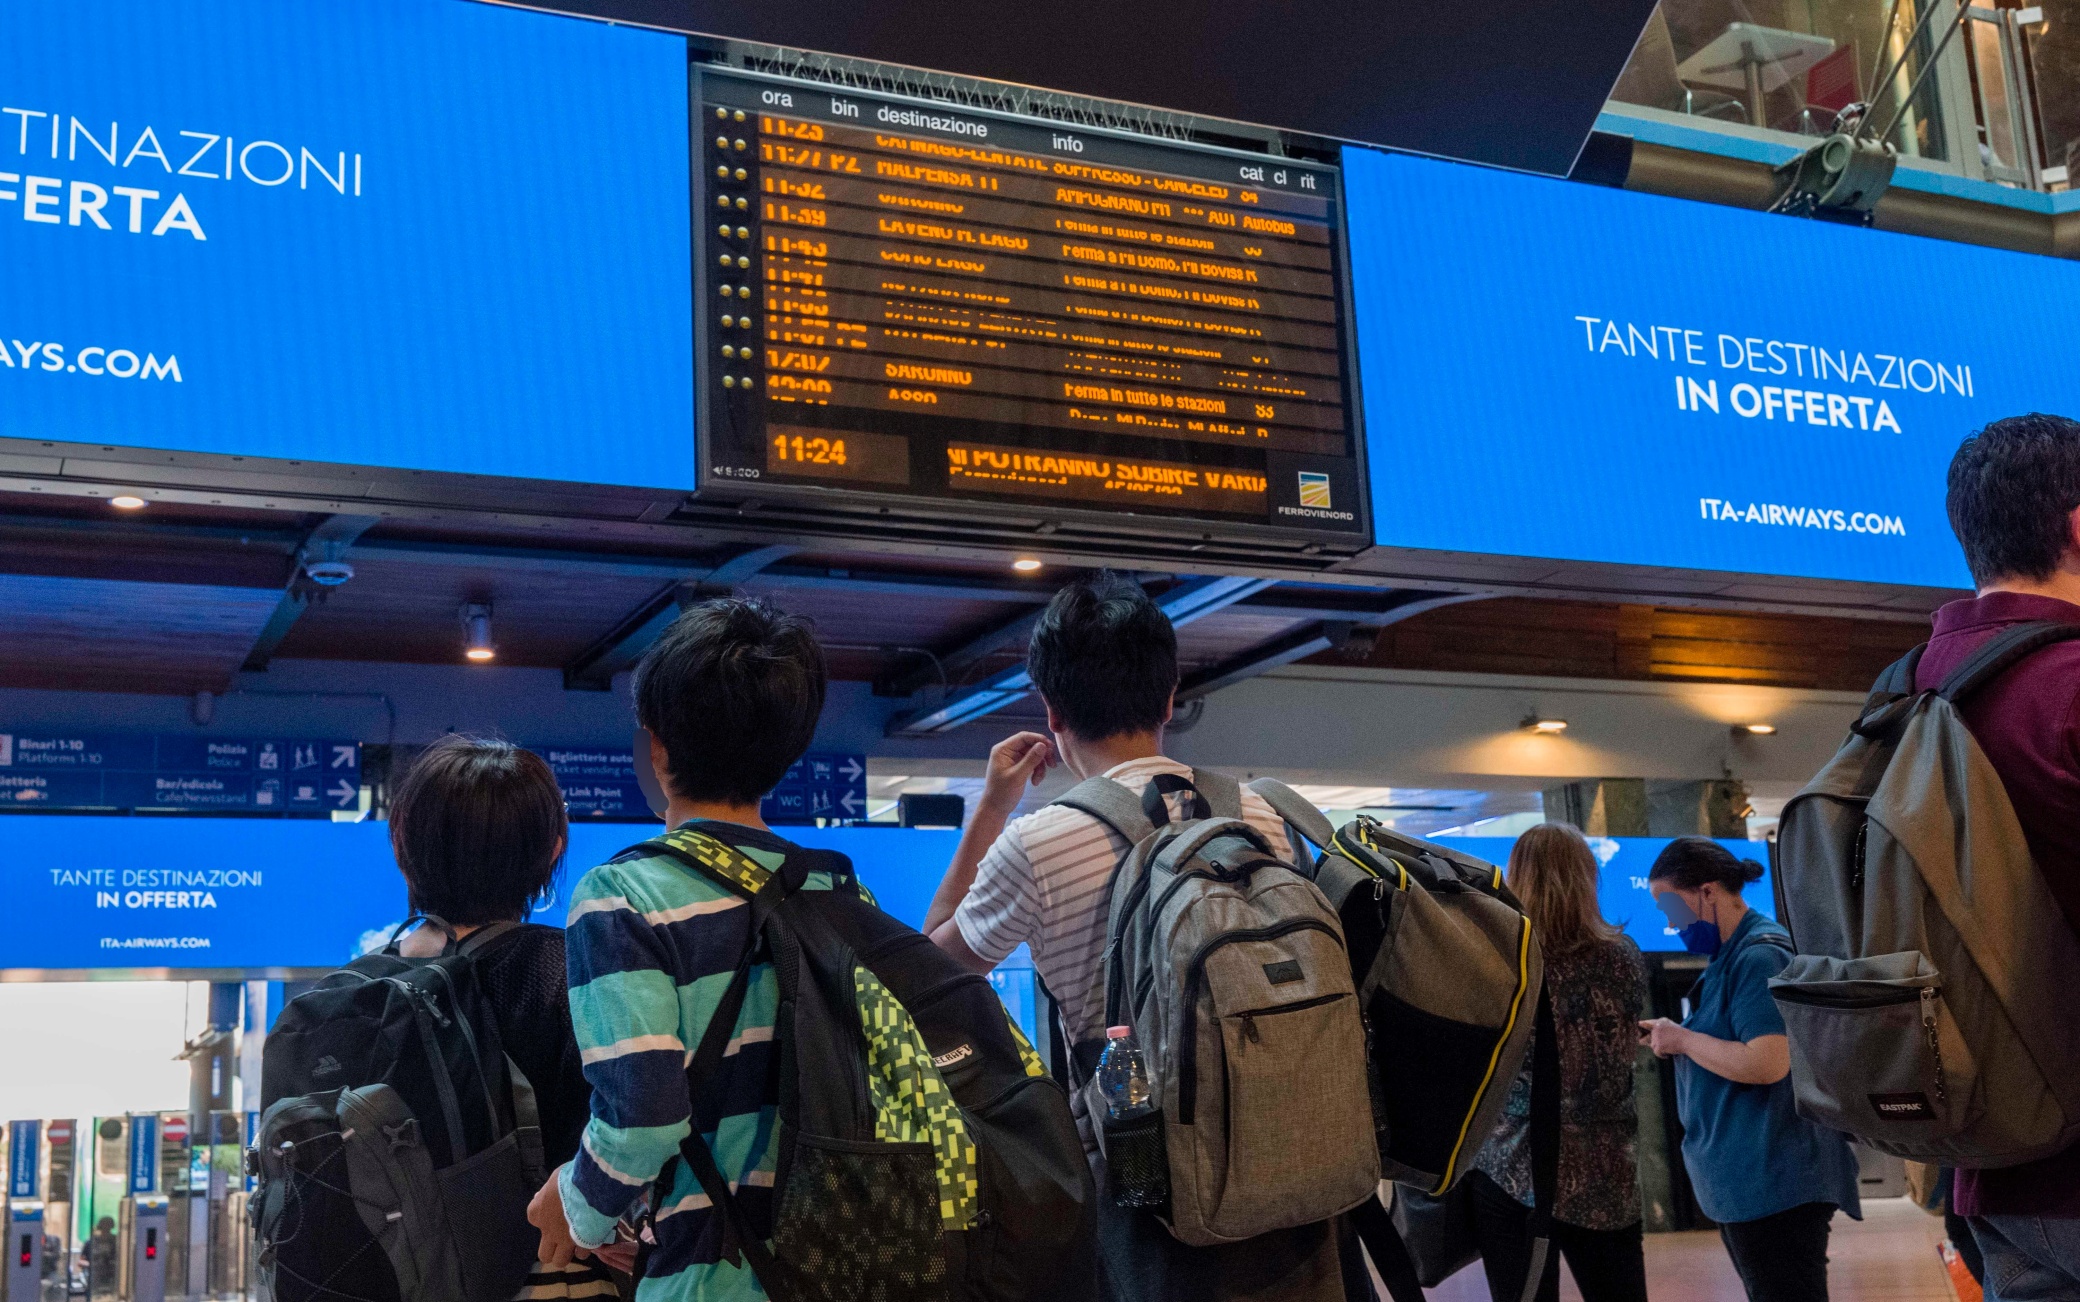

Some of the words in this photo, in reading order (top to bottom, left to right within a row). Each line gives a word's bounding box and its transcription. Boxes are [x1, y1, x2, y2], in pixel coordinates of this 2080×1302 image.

[761, 90, 794, 107] ora
[831, 98, 859, 118] bin
[877, 105, 988, 137] destinazione
[1052, 133, 1084, 153] info
[1240, 165, 1264, 182] cat
[1273, 169, 1287, 185] cl
[1301, 173, 1316, 190] rit
[2, 107, 361, 197] TINAZIONI
[1575, 315, 1706, 366] TANTE
[1718, 334, 1974, 398] DESTINAZIONI
[1675, 375, 1720, 414] IN
[1730, 383, 1902, 434] OFFERTA
[774, 434, 847, 465] 11:24
[1278, 506, 1354, 521] FERROVIENORD
[1700, 497, 1906, 537] ITA-AIRWAYS.COM
[19, 738, 56, 750] Binari
[59, 739, 84, 751] 1-10
[18, 751, 76, 763] Platforms
[594, 787, 622, 797] Point
[780, 795, 802, 807] WC
[50, 869, 115, 887] TANTE
[122, 868, 262, 888] DESTINAZIONI
[97, 891, 120, 908] IN
[124, 891, 217, 909] OFFERTA
[100, 936, 211, 949] ITA-AIRWAYS.COM
[1879, 1103, 1922, 1111] EASTPAK
